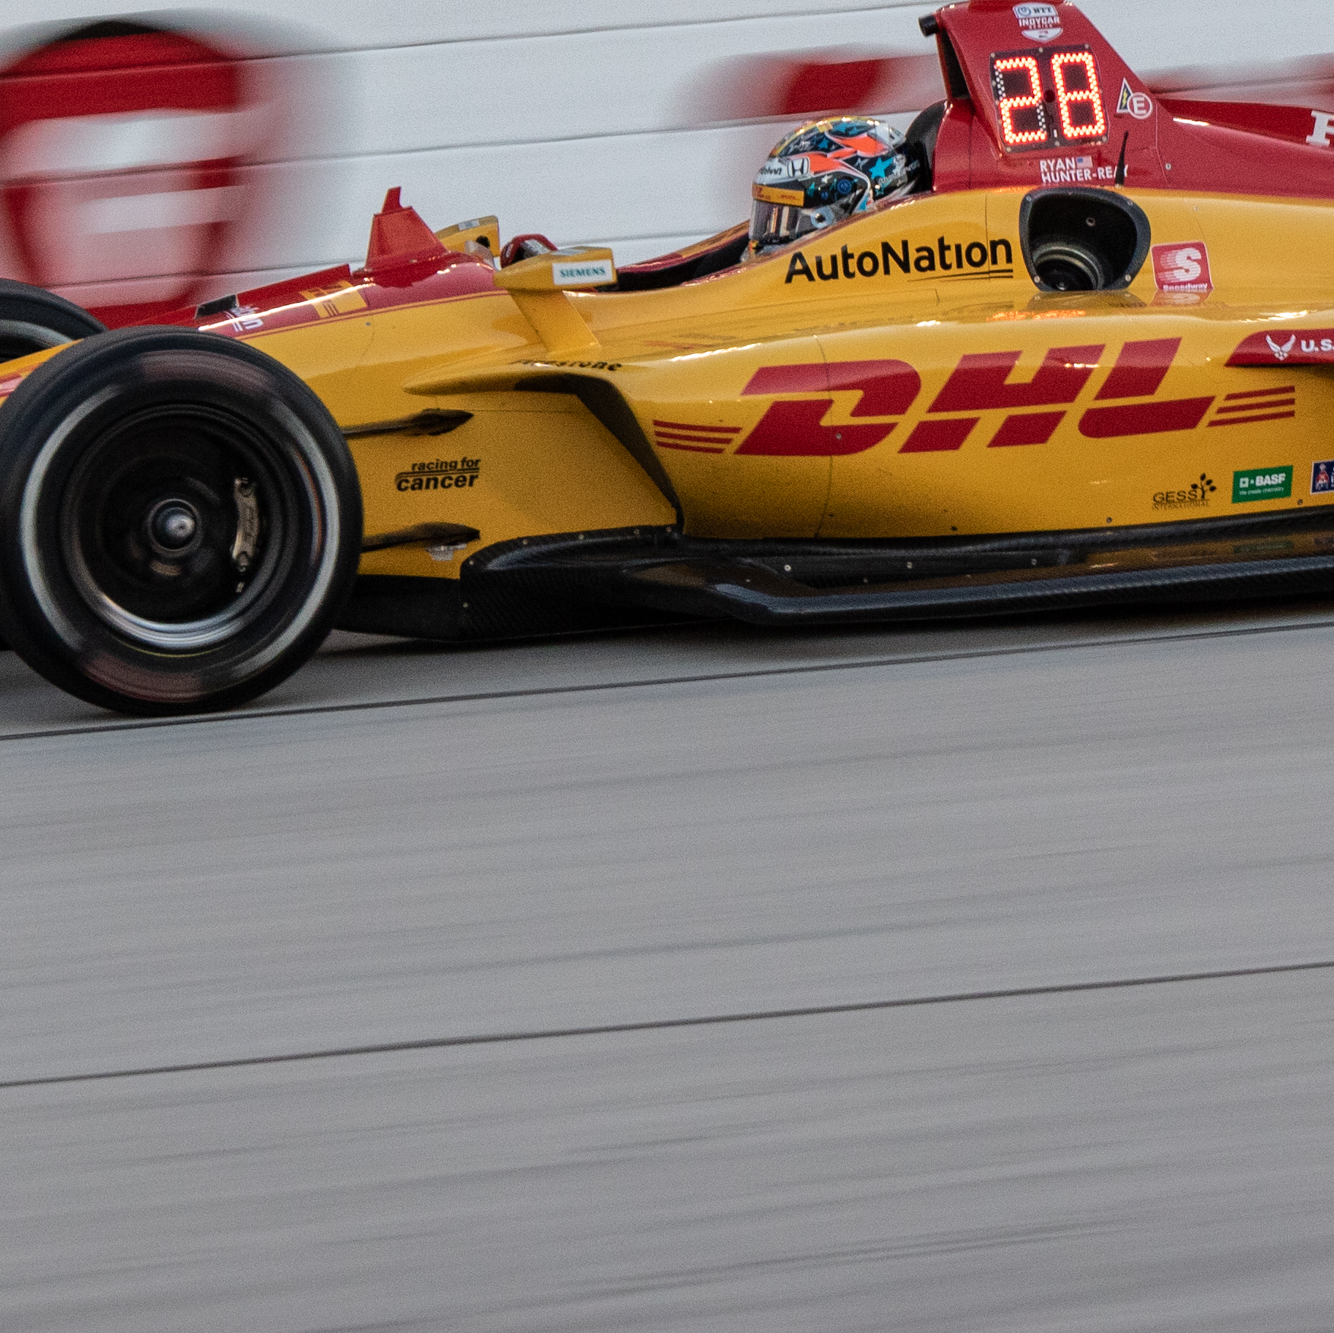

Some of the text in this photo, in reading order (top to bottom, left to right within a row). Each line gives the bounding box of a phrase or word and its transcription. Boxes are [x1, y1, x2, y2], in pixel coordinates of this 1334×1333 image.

[1019, 16, 1060, 27] INDYCAR
[994, 52, 1106, 145] 28
[1040, 157, 1076, 173] RYAN
[784, 236, 1013, 284] AutoNation
[559, 266, 606, 278] SIEMENS
[733, 336, 1217, 457] DHL
[411, 456, 481, 472] racing for
[395, 471, 479, 492] cancer
[1255, 473, 1286, 486] BASF
